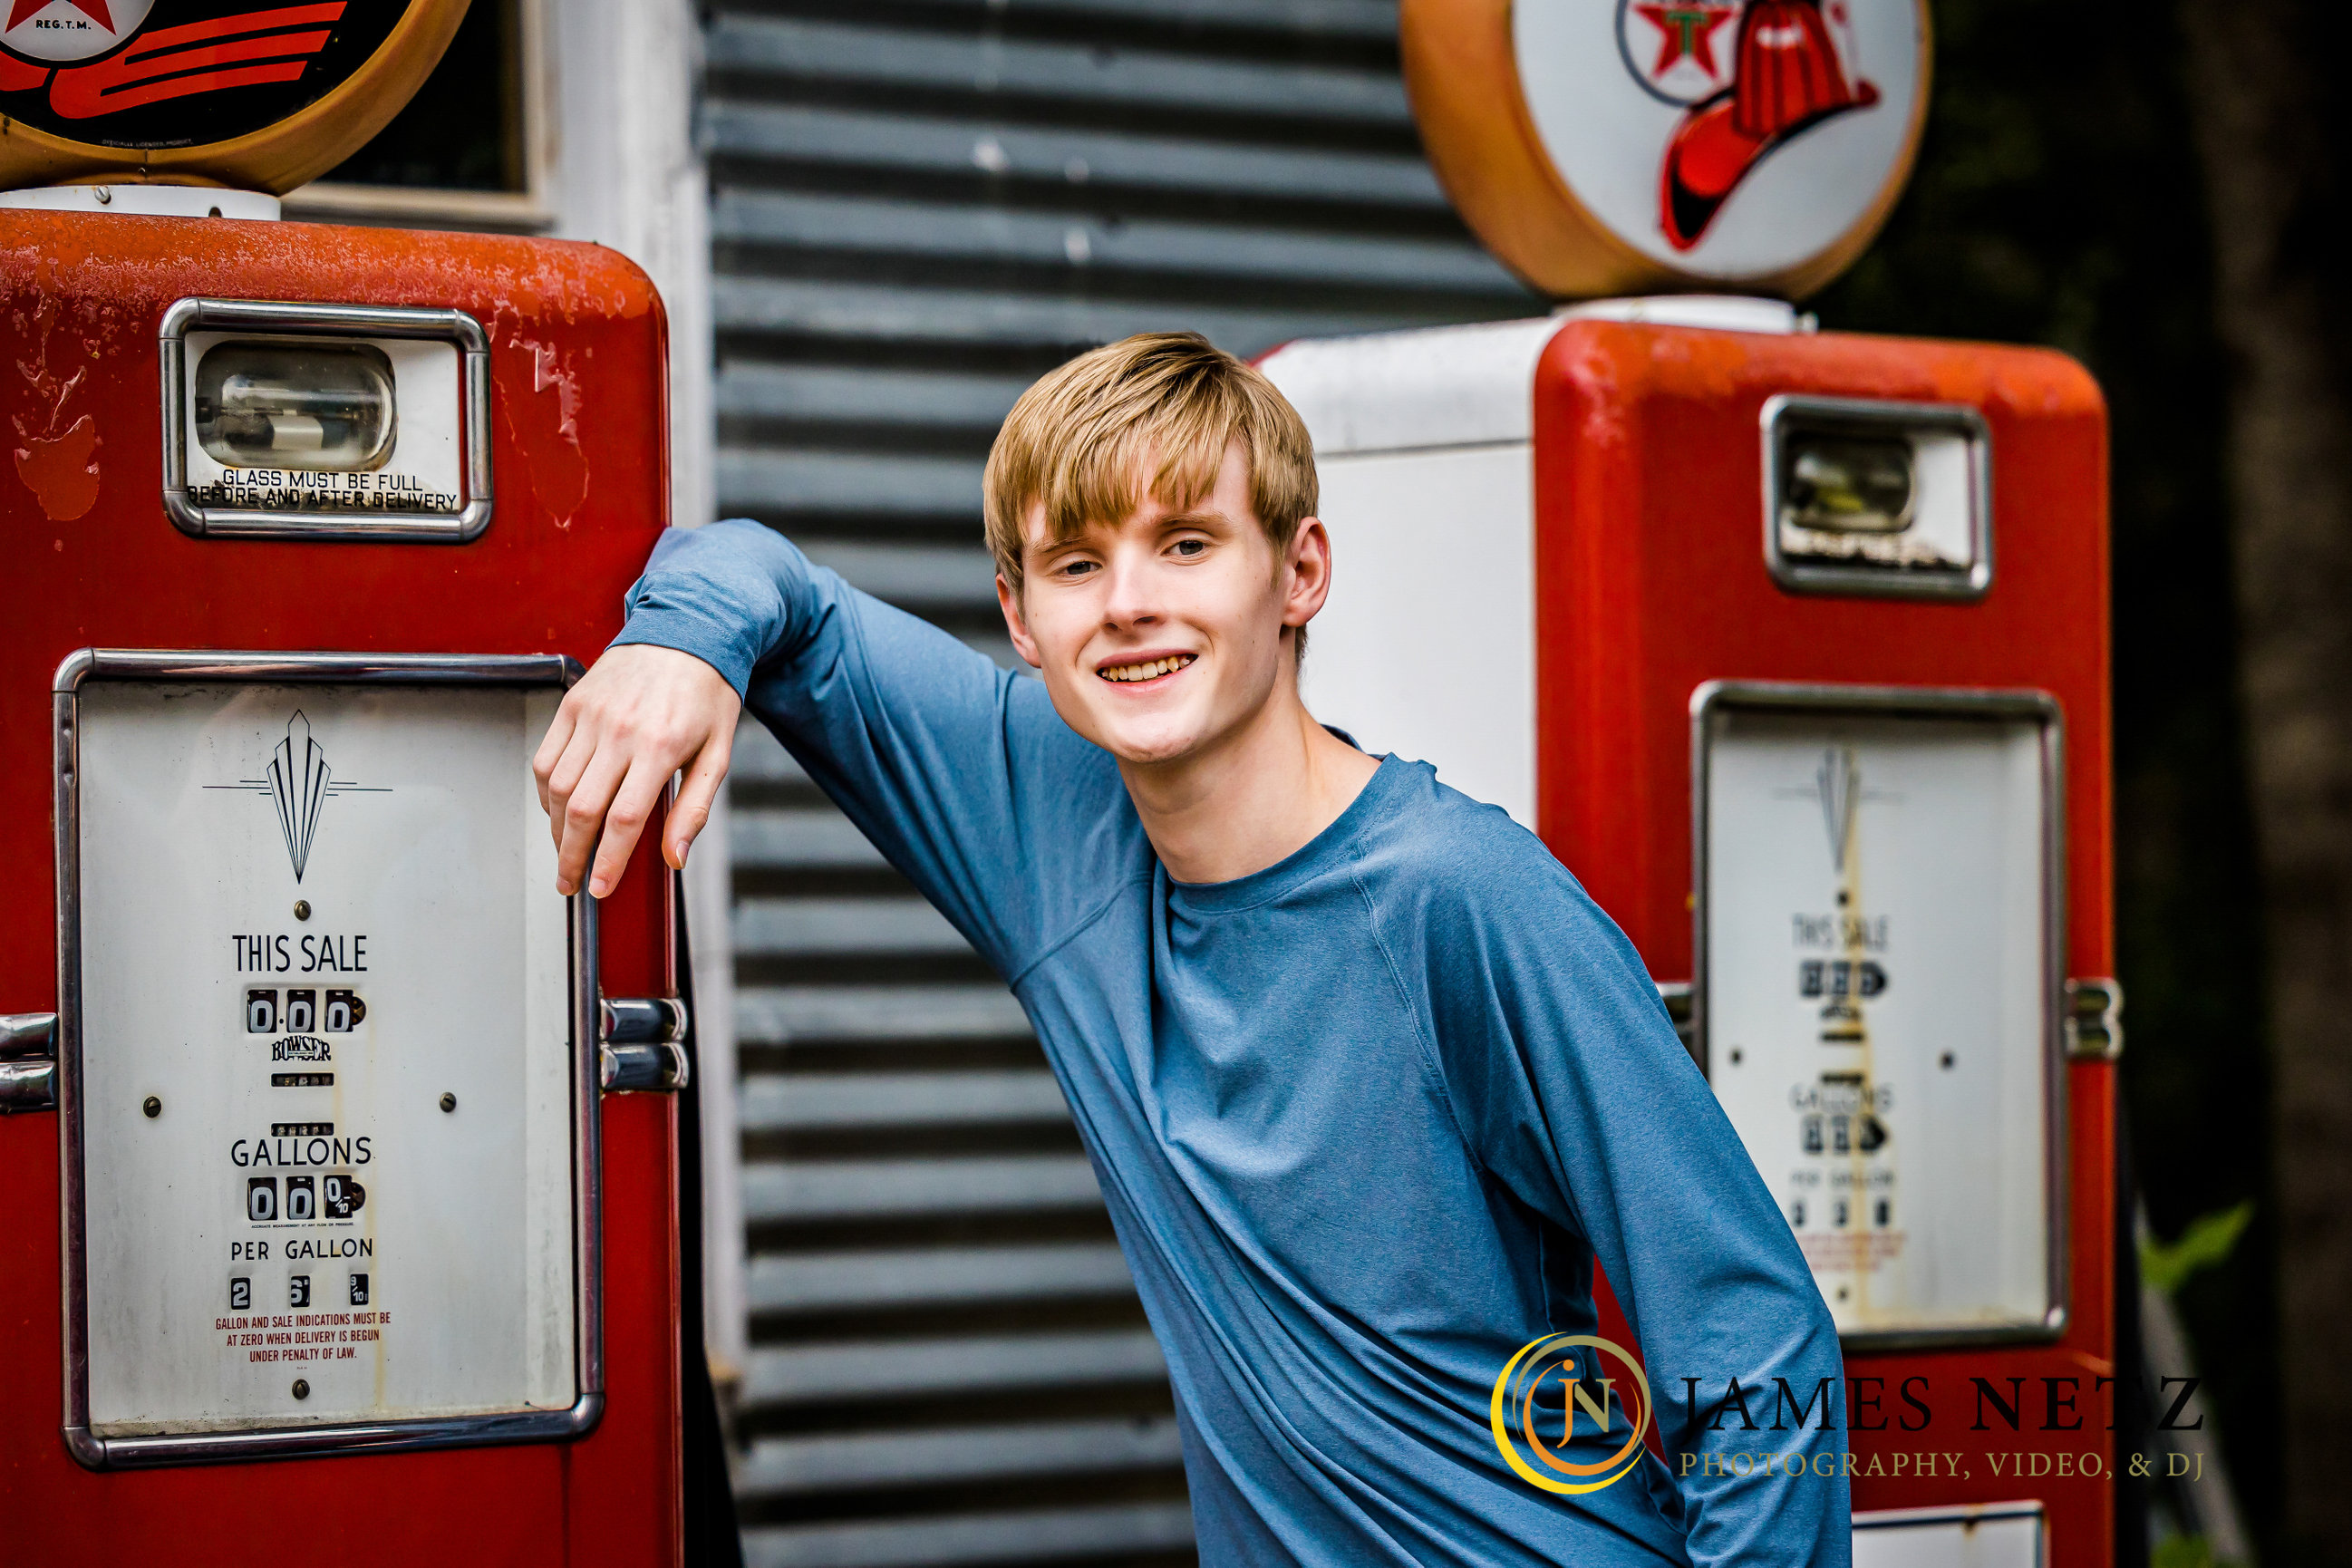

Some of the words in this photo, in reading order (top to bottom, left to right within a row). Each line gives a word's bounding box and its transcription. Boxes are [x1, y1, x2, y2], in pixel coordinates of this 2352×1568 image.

[222, 469, 282, 487] GLASS
[289, 471, 339, 489] MUST
[348, 473, 370, 489] BE
[379, 474, 423, 491] FULL
[189, 486, 258, 504] BEFORE
[266, 488, 299, 506] AND
[306, 489, 364, 507] AFTER
[373, 492, 457, 509] DELIVERY
[232, 934, 291, 973] THIS
[300, 934, 368, 973] SALE
[272, 1035, 331, 1061] BOWSER
[231, 1137, 372, 1167] GALLONS
[231, 1241, 269, 1261] PER
[286, 1238, 373, 1259] GALLON
[233, 1282, 248, 1306] 2
[216, 1317, 248, 1330] GALLON
[251, 1316, 269, 1329] AND
[272, 1315, 293, 1328] SALE
[296, 1313, 351, 1327] INDICATIONS
[353, 1312, 377, 1324] MUST
[380, 1312, 391, 1324] BE
[227, 1334, 237, 1346] AT
[240, 1333, 263, 1346] ZERO
[266, 1332, 292, 1345] WHEN
[295, 1331, 336, 1344] DELIVERY
[339, 1331, 347, 1342] IS
[351, 1329, 380, 1341] BEGUN
[249, 1350, 278, 1362] UNDER
[283, 1348, 319, 1361] PENALTY
[323, 1348, 334, 1360] OF
[337, 1347, 357, 1359] LAW.
